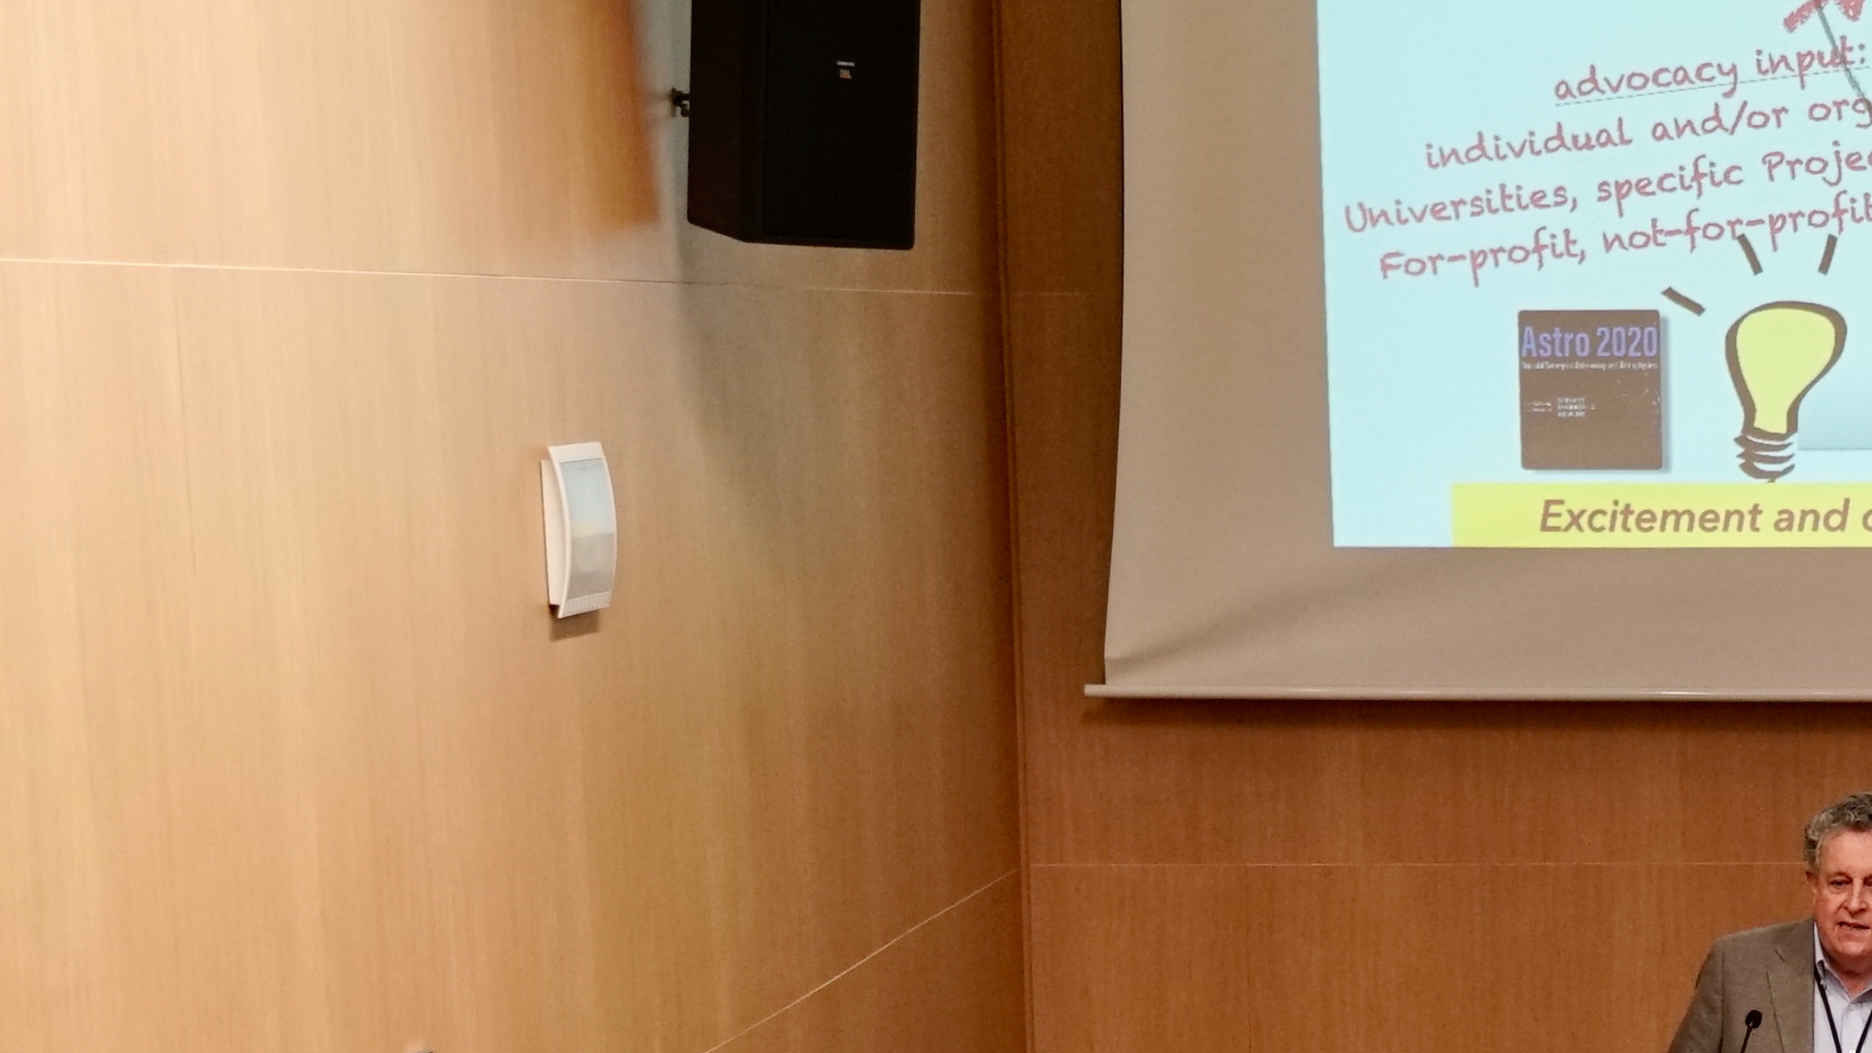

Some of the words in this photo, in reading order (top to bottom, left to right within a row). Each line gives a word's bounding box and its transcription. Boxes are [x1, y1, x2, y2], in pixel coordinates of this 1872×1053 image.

[1554, 60, 1737, 98] advocacy
[1755, 36, 1867, 90] input:
[1426, 116, 1632, 169] individual
[1651, 101, 1789, 136] and/or
[1344, 183, 1579, 233] Universities,
[1597, 154, 1744, 219] specific
[1379, 226, 1586, 288] For-profit,
[1520, 325, 1591, 358] Astro
[1596, 326, 1659, 358] 2020
[1539, 499, 1763, 533] Excitement
[1773, 497, 1851, 533] and
